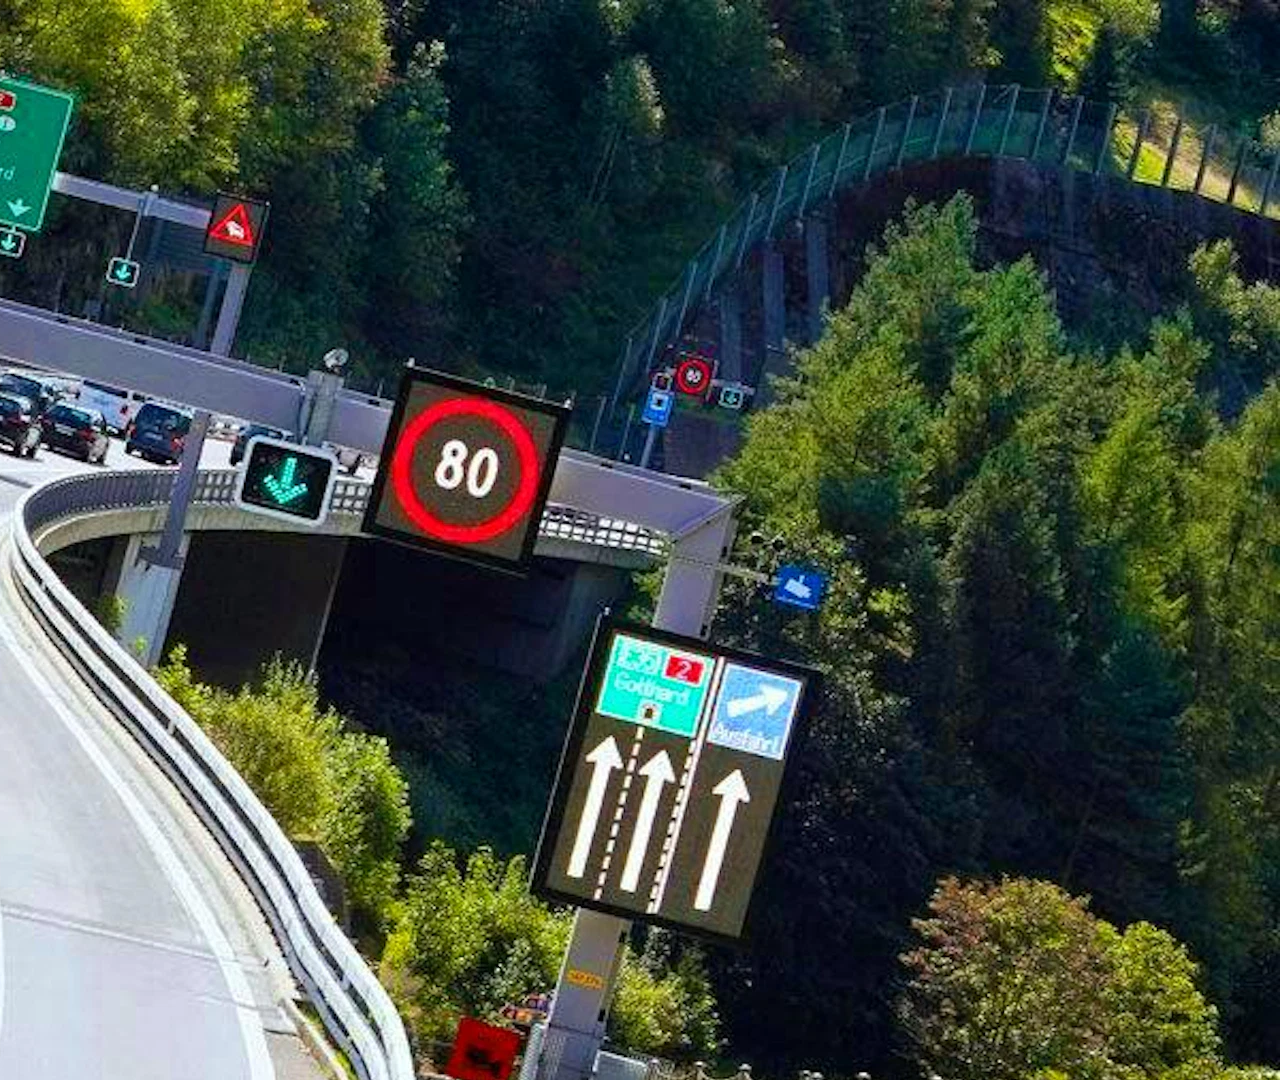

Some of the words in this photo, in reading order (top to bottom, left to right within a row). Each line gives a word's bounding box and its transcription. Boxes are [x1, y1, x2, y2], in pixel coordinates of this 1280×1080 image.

[434, 439, 499, 499] 80
[675, 660, 691, 680] 2
[614, 672, 689, 705] Gotthard
